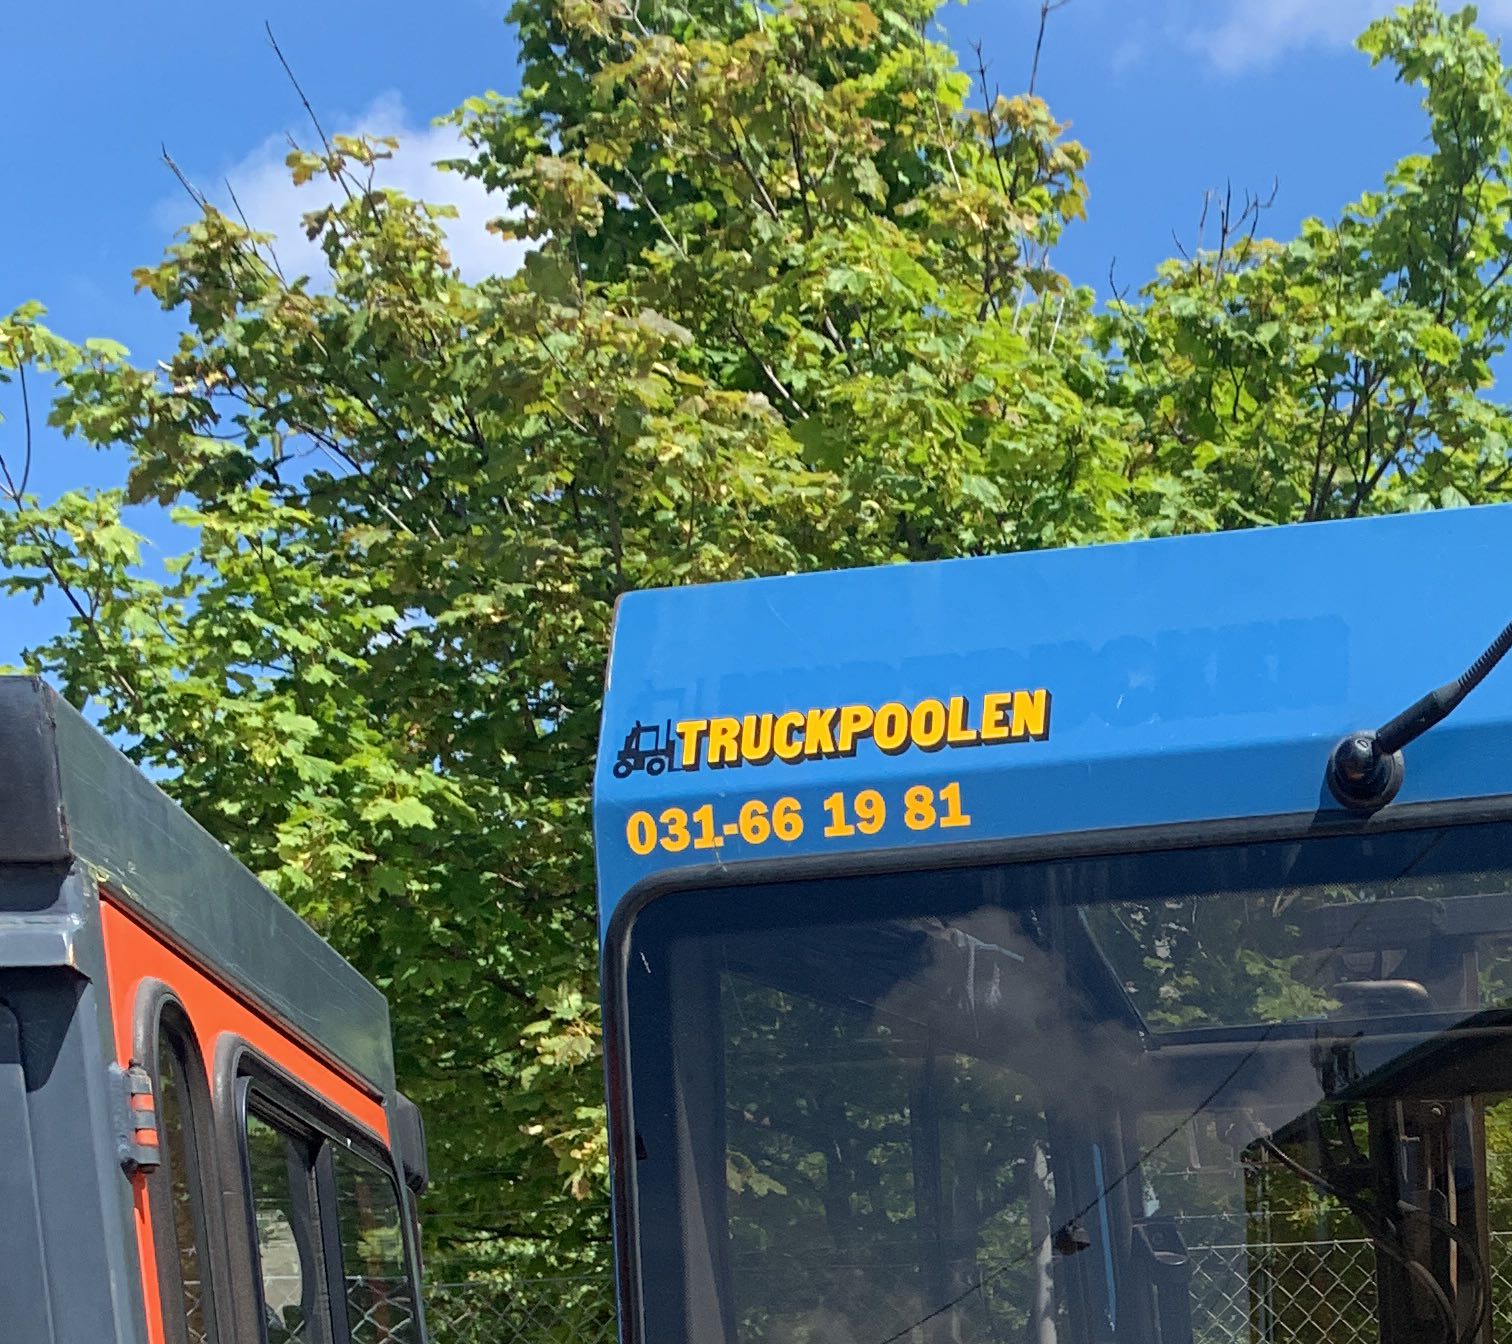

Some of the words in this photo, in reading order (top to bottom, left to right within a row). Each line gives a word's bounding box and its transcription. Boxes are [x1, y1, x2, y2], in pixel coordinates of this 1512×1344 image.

[676, 689, 1051, 770] TRUCKPOOLEN
[626, 796, 804, 855] 031-66
[824, 789, 886, 838] 19
[904, 782, 971, 830] 81
